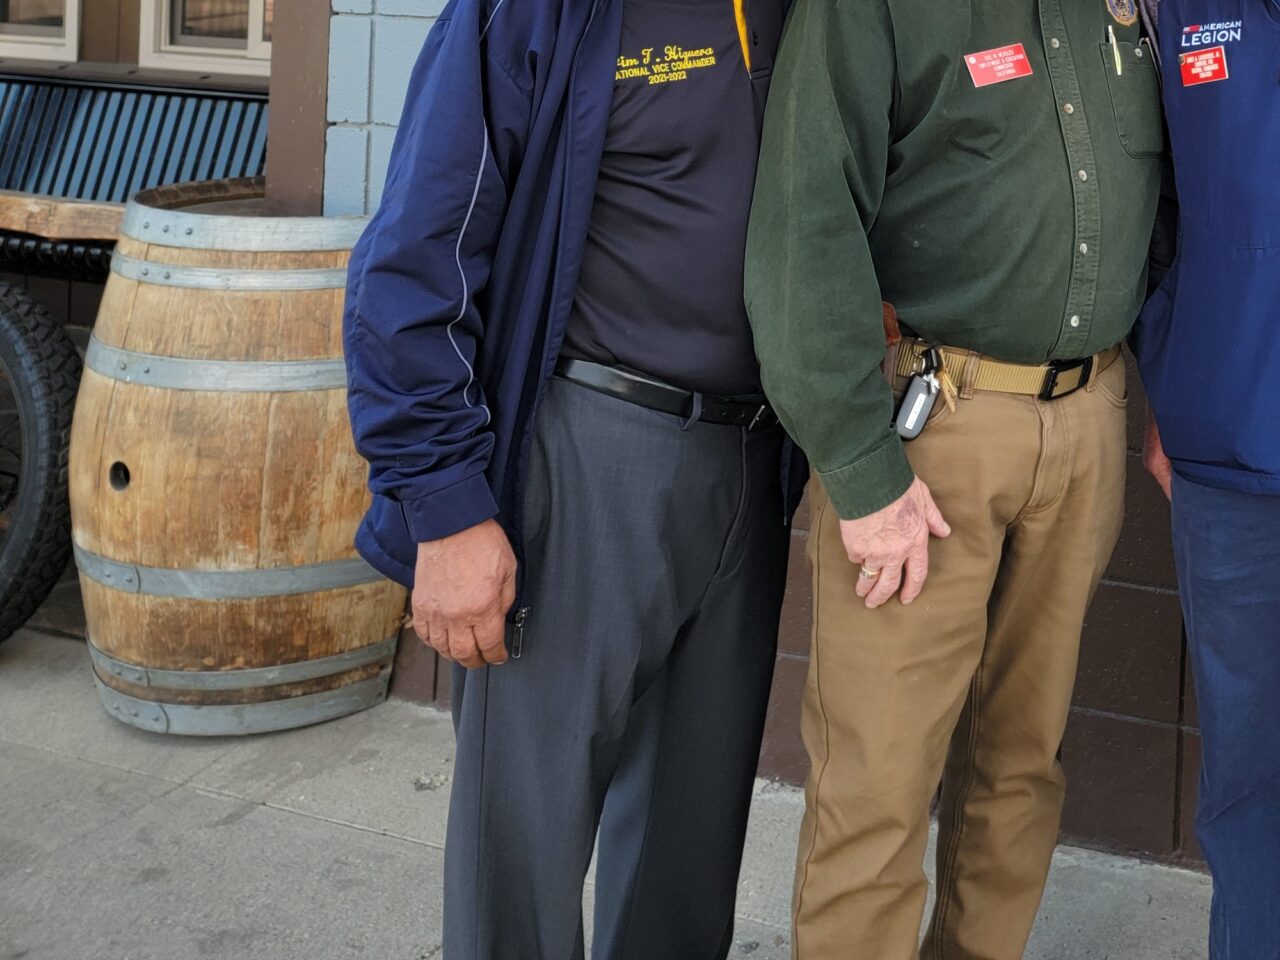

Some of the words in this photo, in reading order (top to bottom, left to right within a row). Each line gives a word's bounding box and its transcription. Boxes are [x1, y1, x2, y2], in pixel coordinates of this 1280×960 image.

[1199, 20, 1242, 32] AMERICAN
[1181, 28, 1241, 47] LEGION
[615, 67, 650, 80] ATIONAL
[652, 63, 670, 73] VICE
[671, 57, 716, 70] COMMANDER
